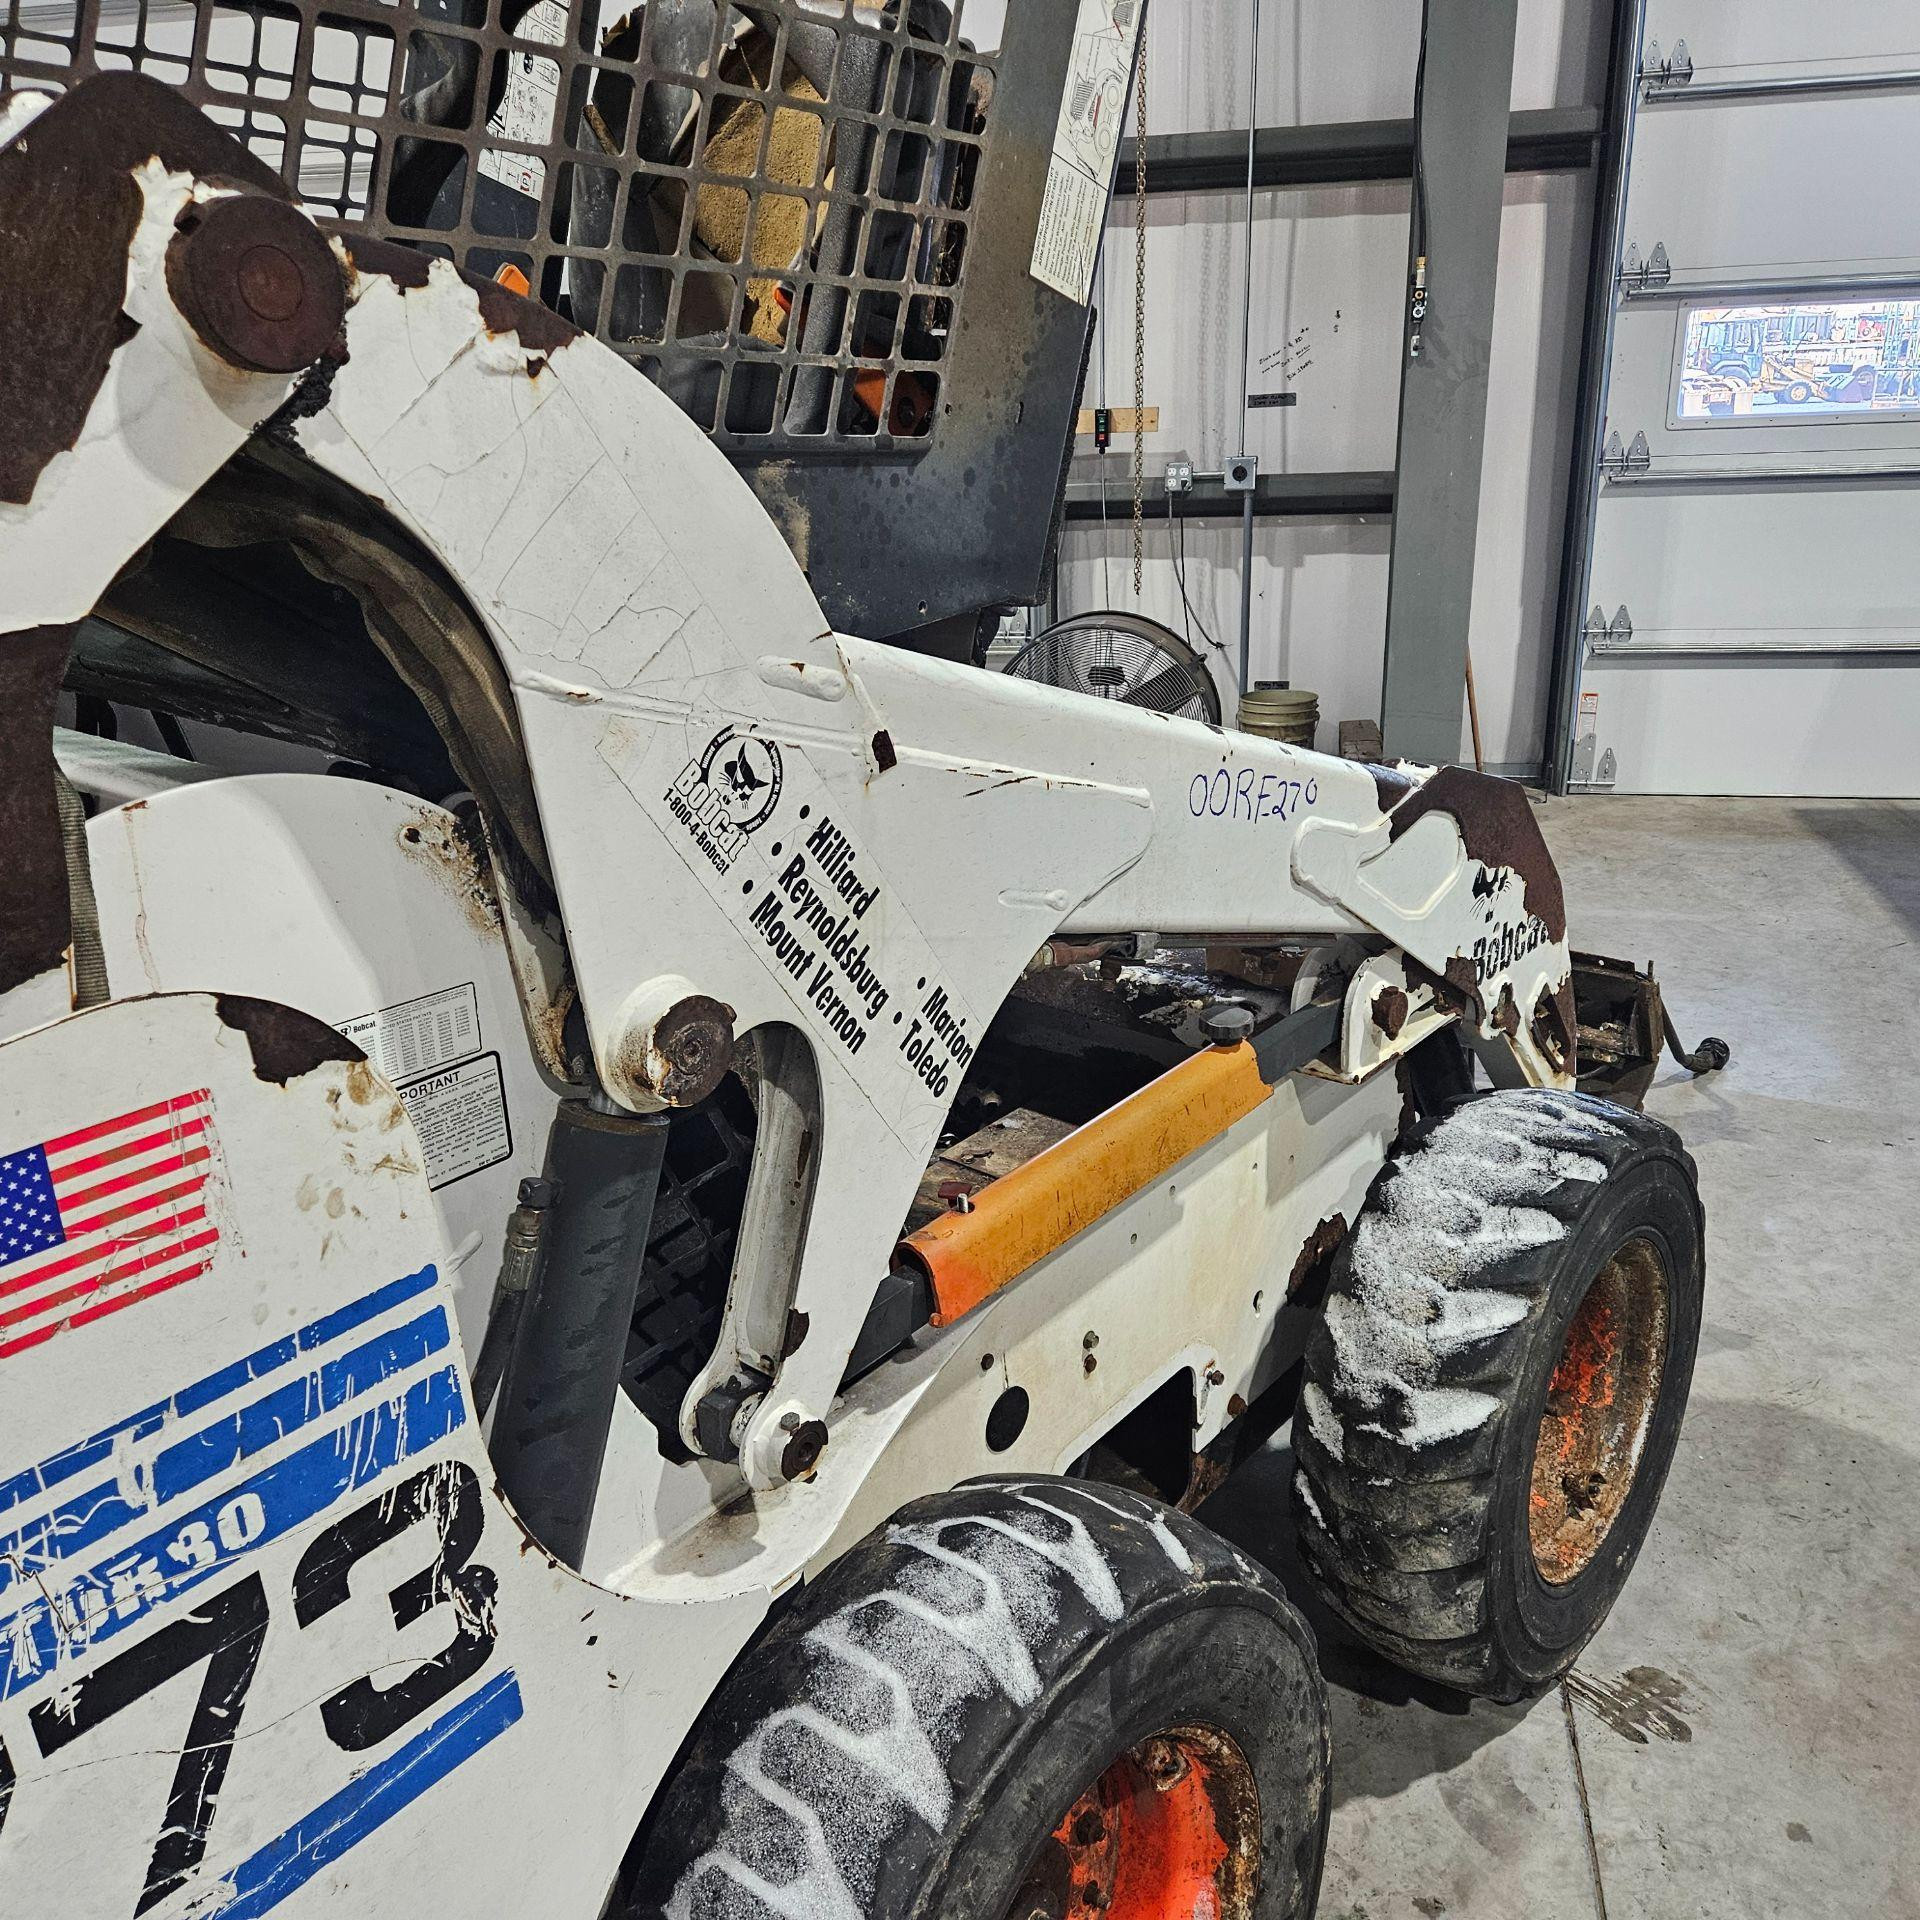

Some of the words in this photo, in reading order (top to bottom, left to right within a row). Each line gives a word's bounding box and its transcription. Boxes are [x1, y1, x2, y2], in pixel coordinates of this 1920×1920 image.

[663, 788, 730, 876] 1-800-4-Bobcat
[673, 758, 749, 863] Bobcat
[806, 816, 880, 920] Hilliard
[749, 891, 815, 980] Mount
[807, 962, 866, 1054] Vernon
[778, 853, 889, 1020] Reynoldsburg
[353, 1020, 376, 1033] Bobcat
[899, 1018, 949, 1097] Toledo
[921, 986, 980, 1069] Marion
[400, 1071, 460, 1099] PORTANT
[0, 1461, 499, 1919] 73
